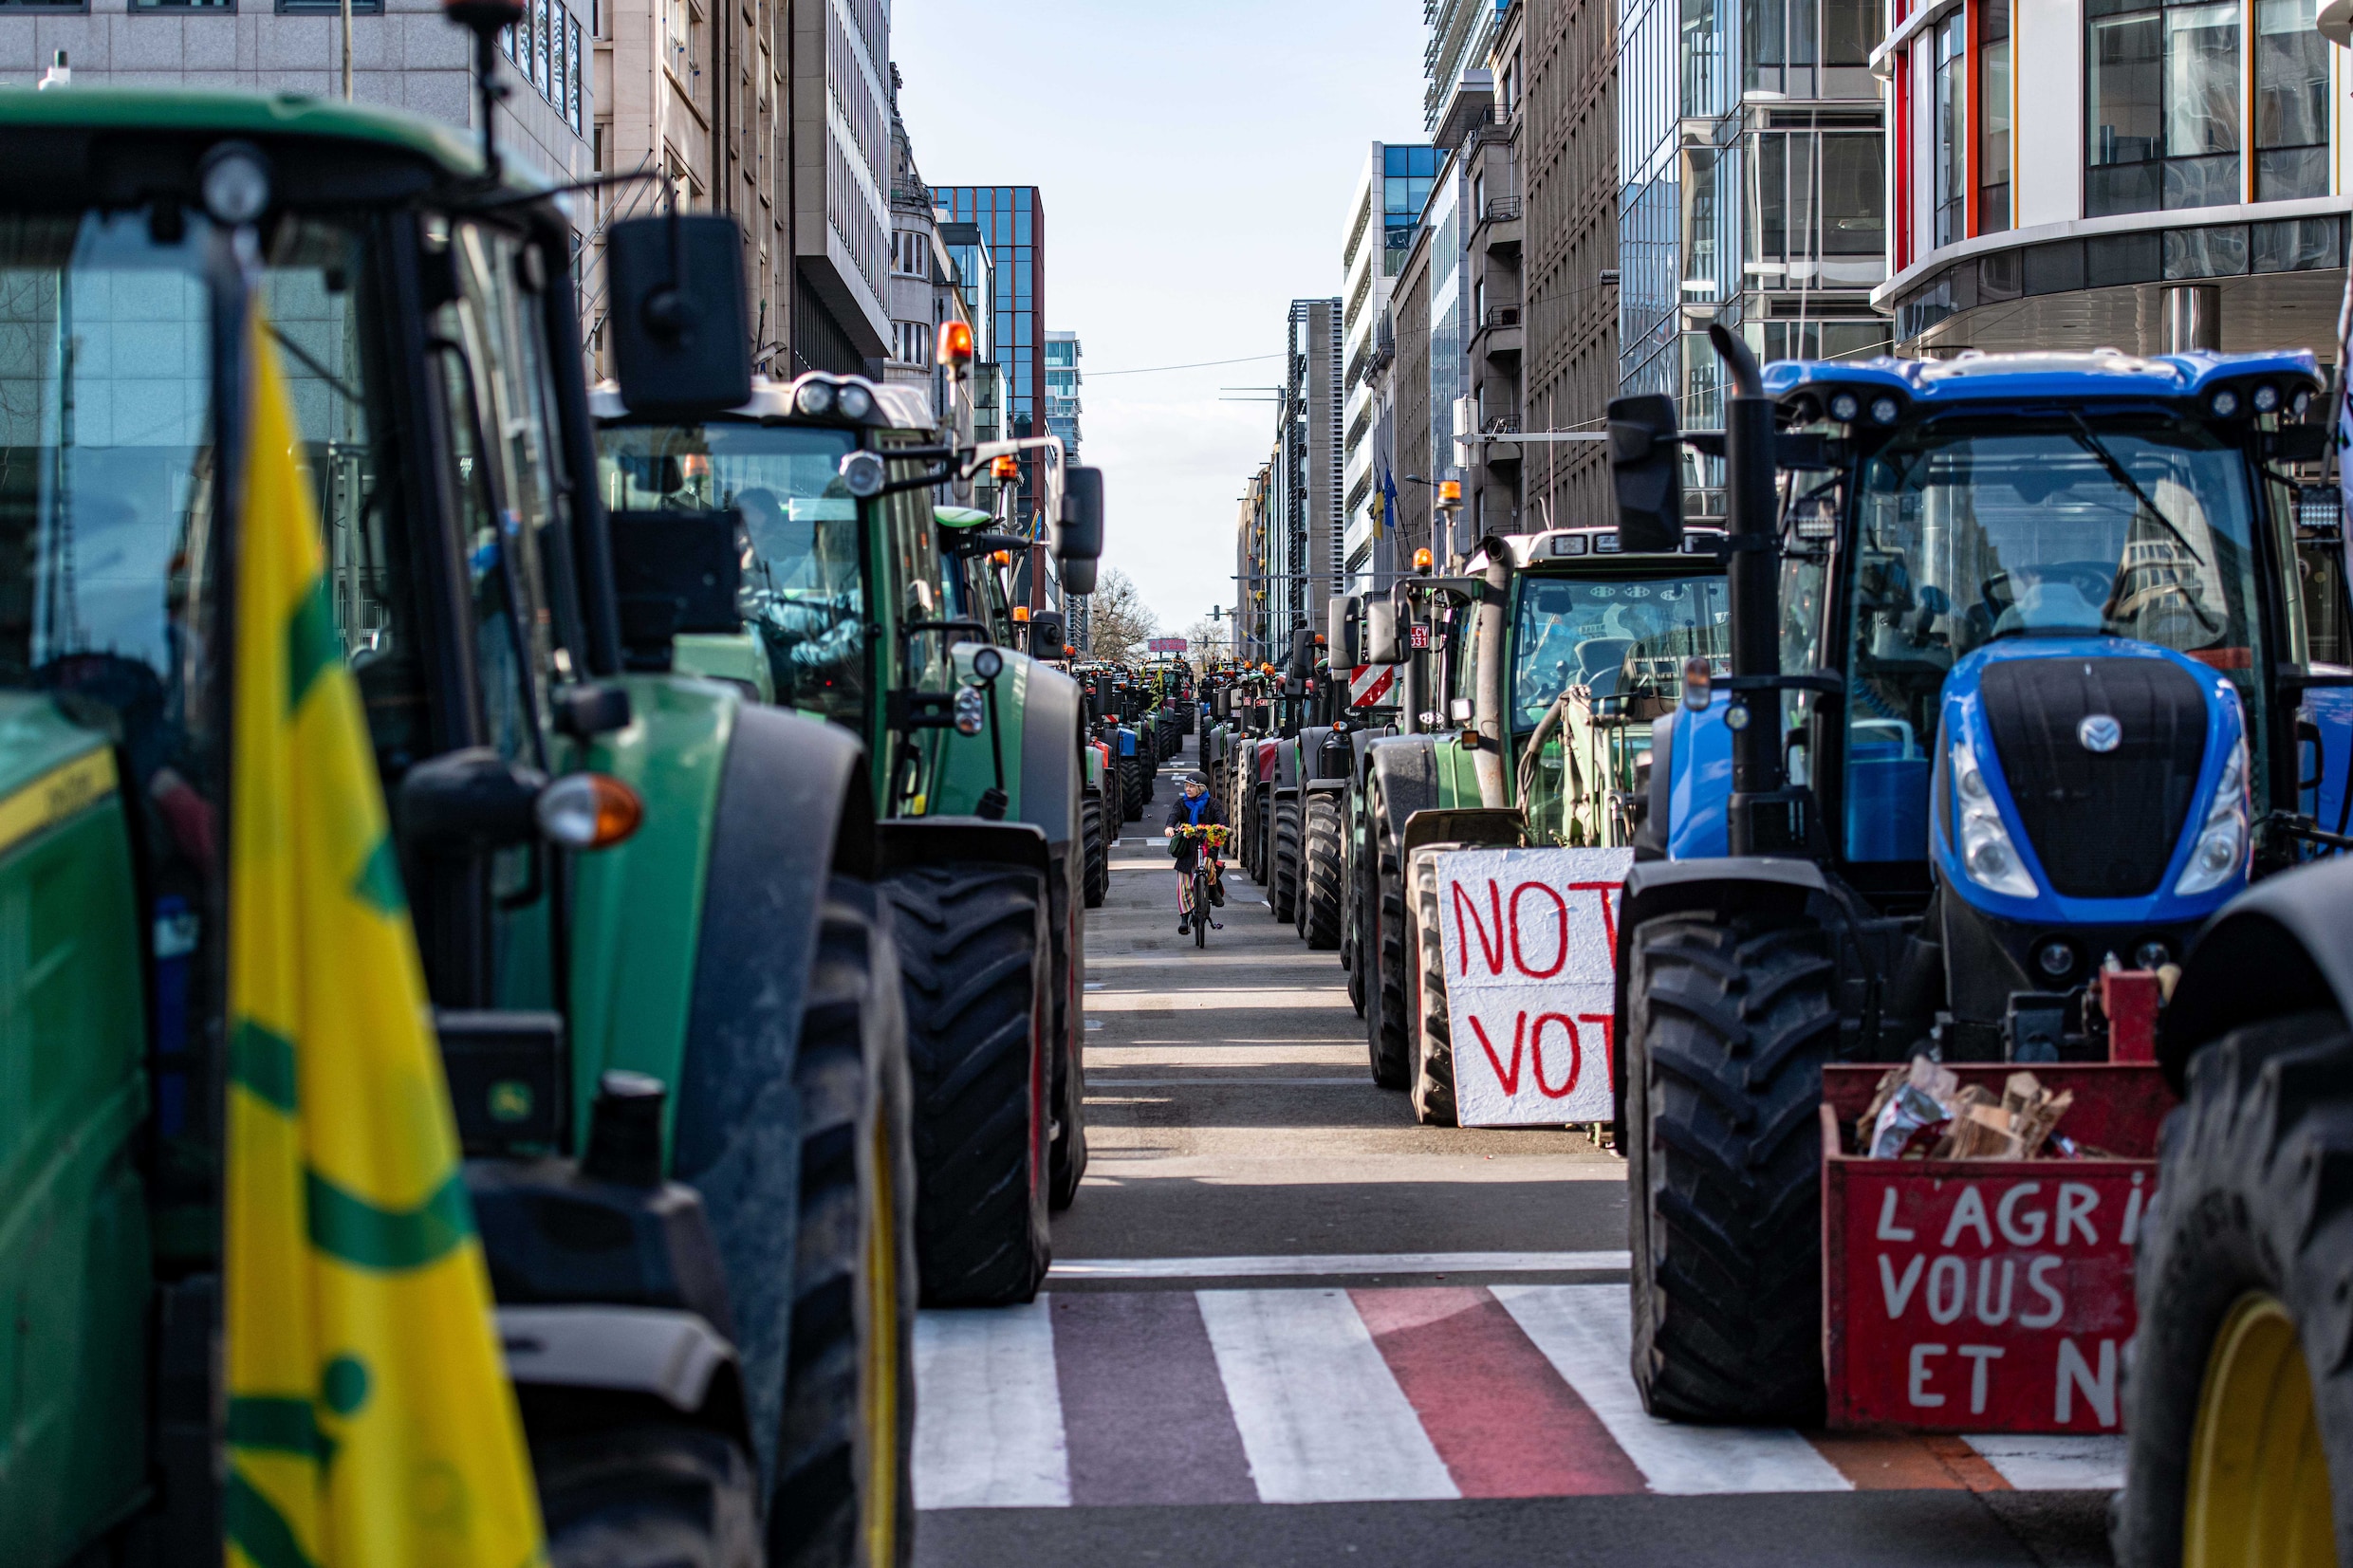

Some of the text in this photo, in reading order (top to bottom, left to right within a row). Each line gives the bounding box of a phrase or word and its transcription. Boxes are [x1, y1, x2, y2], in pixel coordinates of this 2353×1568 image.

[1452, 878, 1623, 979] NOT
[1468, 1010, 1615, 1099] VOT
[1878, 1252, 2065, 1329] VOUS
[1908, 1337, 2118, 1428] ET N
